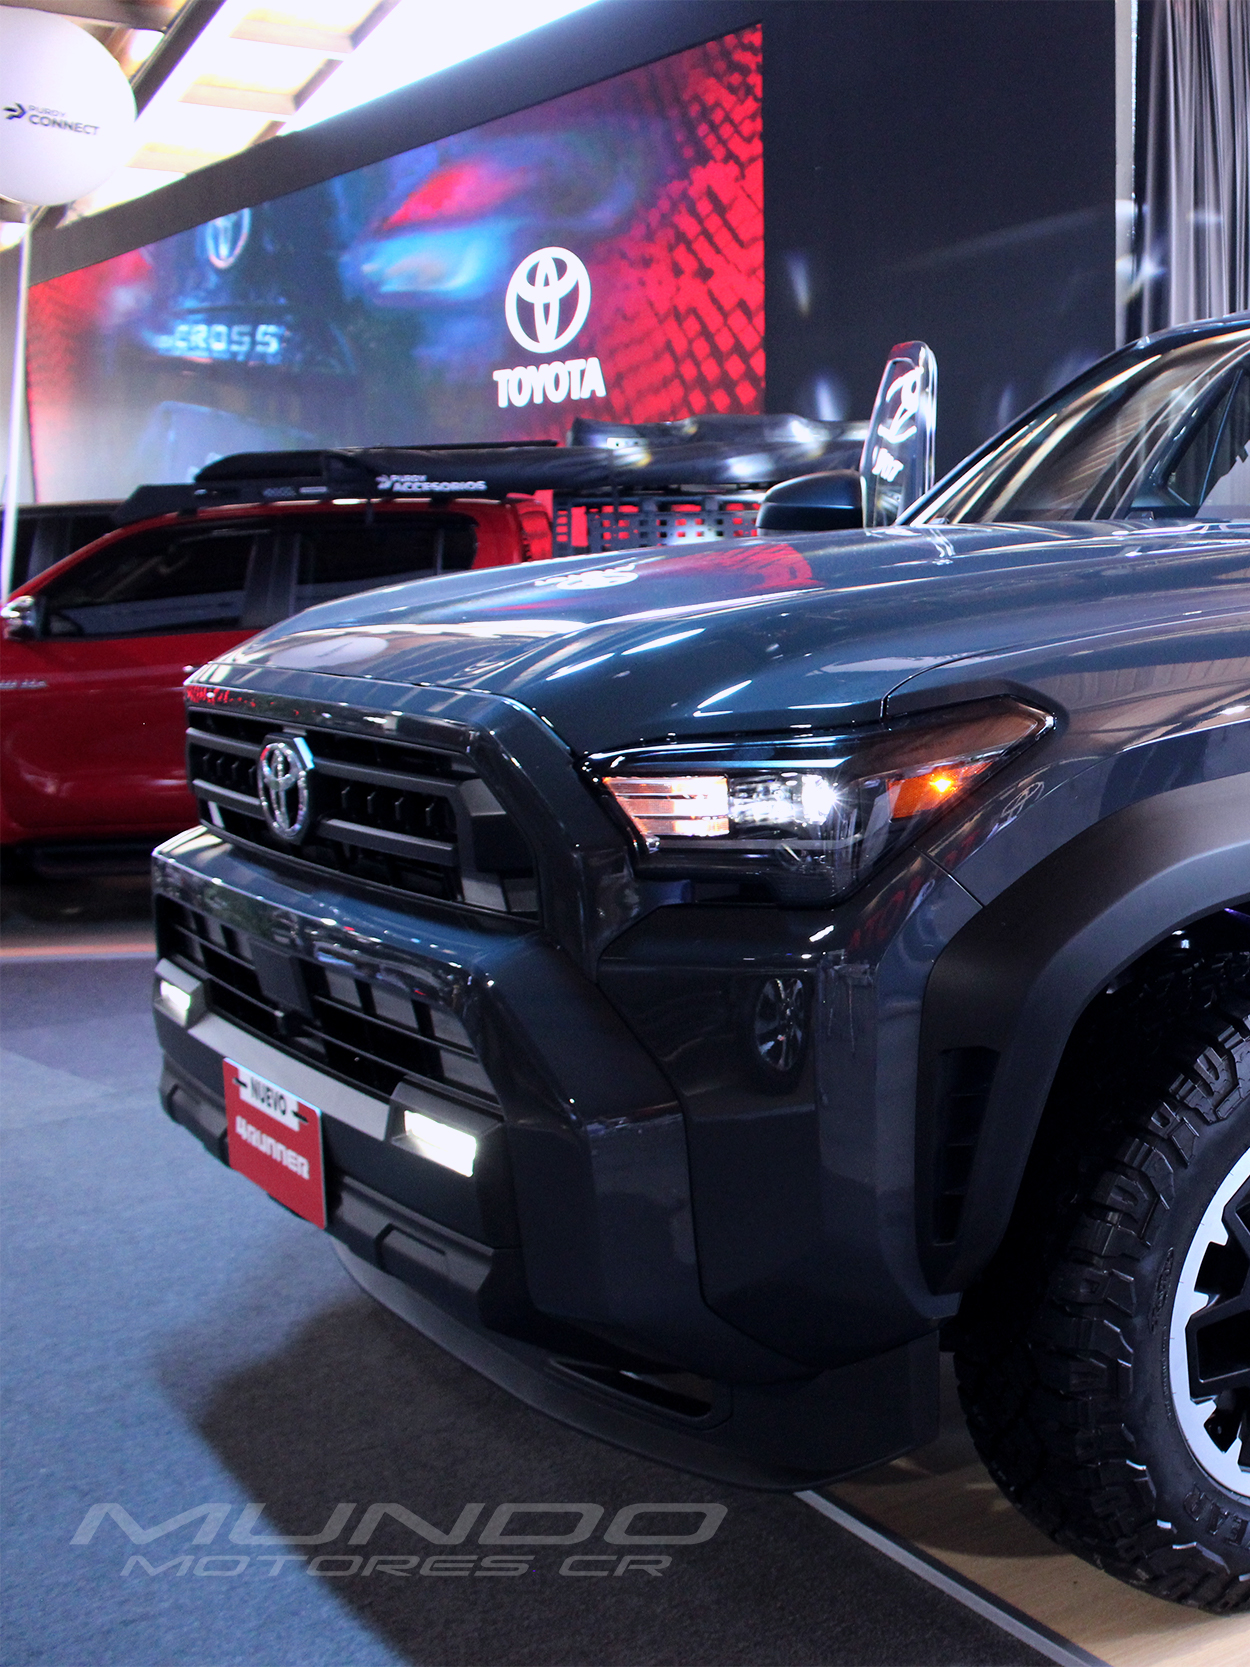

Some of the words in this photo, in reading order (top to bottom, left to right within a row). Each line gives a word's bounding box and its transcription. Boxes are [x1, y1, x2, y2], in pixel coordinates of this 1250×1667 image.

[28, 114, 99, 135] CONNECT
[492, 356, 607, 408] TOYOTA
[250, 1077, 287, 1116] NUEVO
